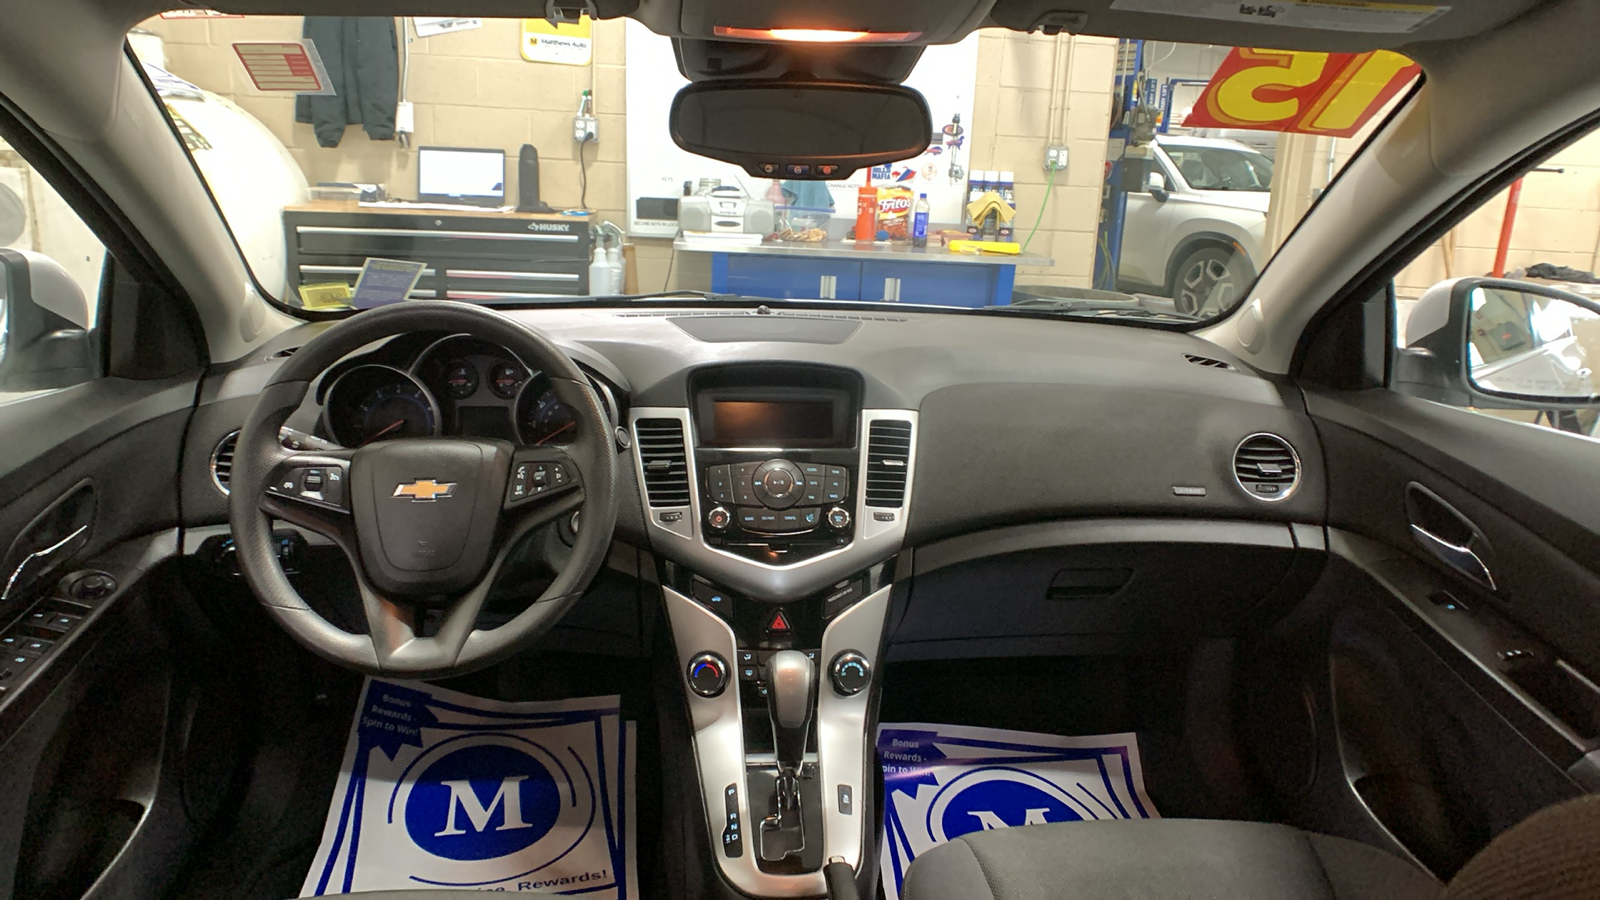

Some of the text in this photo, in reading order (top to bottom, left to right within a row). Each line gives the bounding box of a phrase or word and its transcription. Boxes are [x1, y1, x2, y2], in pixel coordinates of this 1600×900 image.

[541, 38, 571, 47] Matthews
[572, 41, 587, 49] Auto
[878, 198, 911, 213] Fritos
[539, 223, 570, 232] HUSKY
[383, 693, 412, 708] Bonus
[371, 704, 412, 722] Rewards
[362, 716, 419, 737] Spin to Win!
[892, 738, 920, 749] Bonus
[883, 750, 922, 763] Rewards
[882, 764, 897, 773] pin
[434, 775, 534, 837] M
[517, 869, 608, 892] Rewards!
